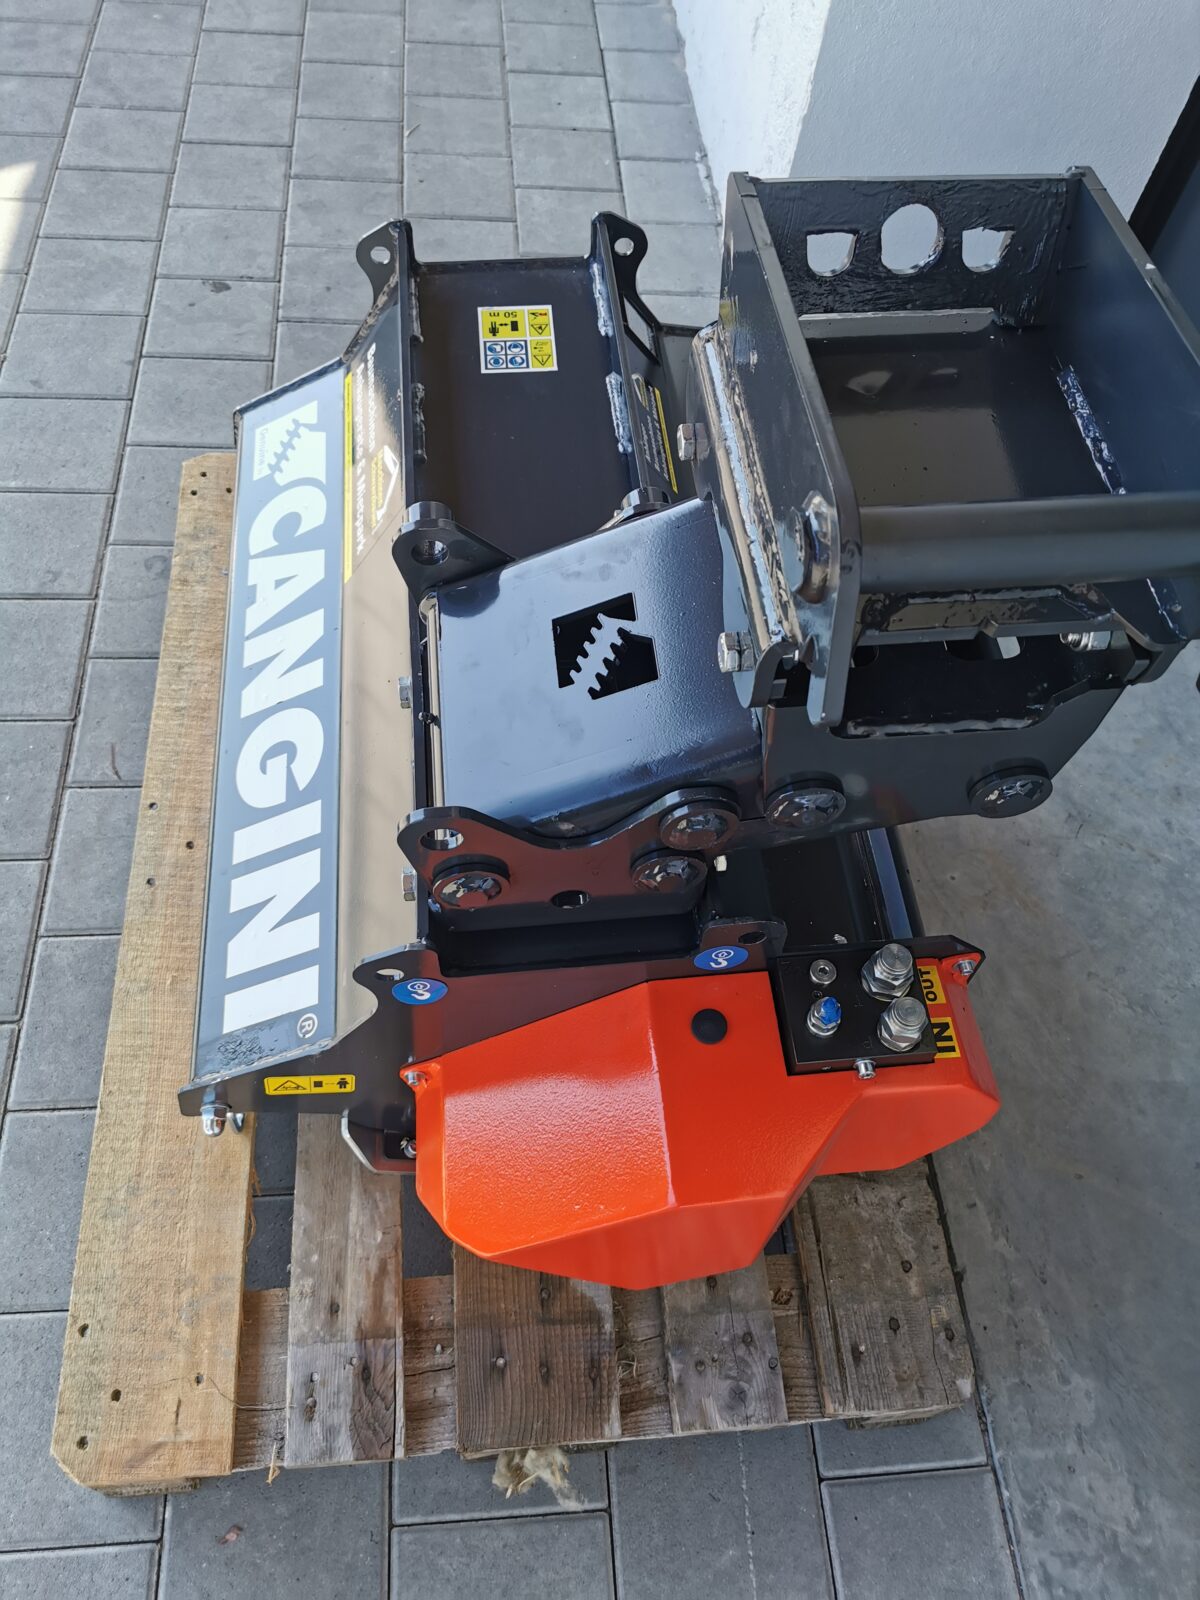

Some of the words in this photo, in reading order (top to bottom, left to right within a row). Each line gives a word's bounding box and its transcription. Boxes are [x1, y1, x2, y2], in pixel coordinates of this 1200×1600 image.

[503, 311, 518, 319] 50
[366, 342, 377, 453] Baumaschinen
[355, 473, 366, 556] Mietpark
[223, 485, 327, 1034] CANGINI
[919, 967, 938, 1003] OUT
[931, 1022, 957, 1054] IN
